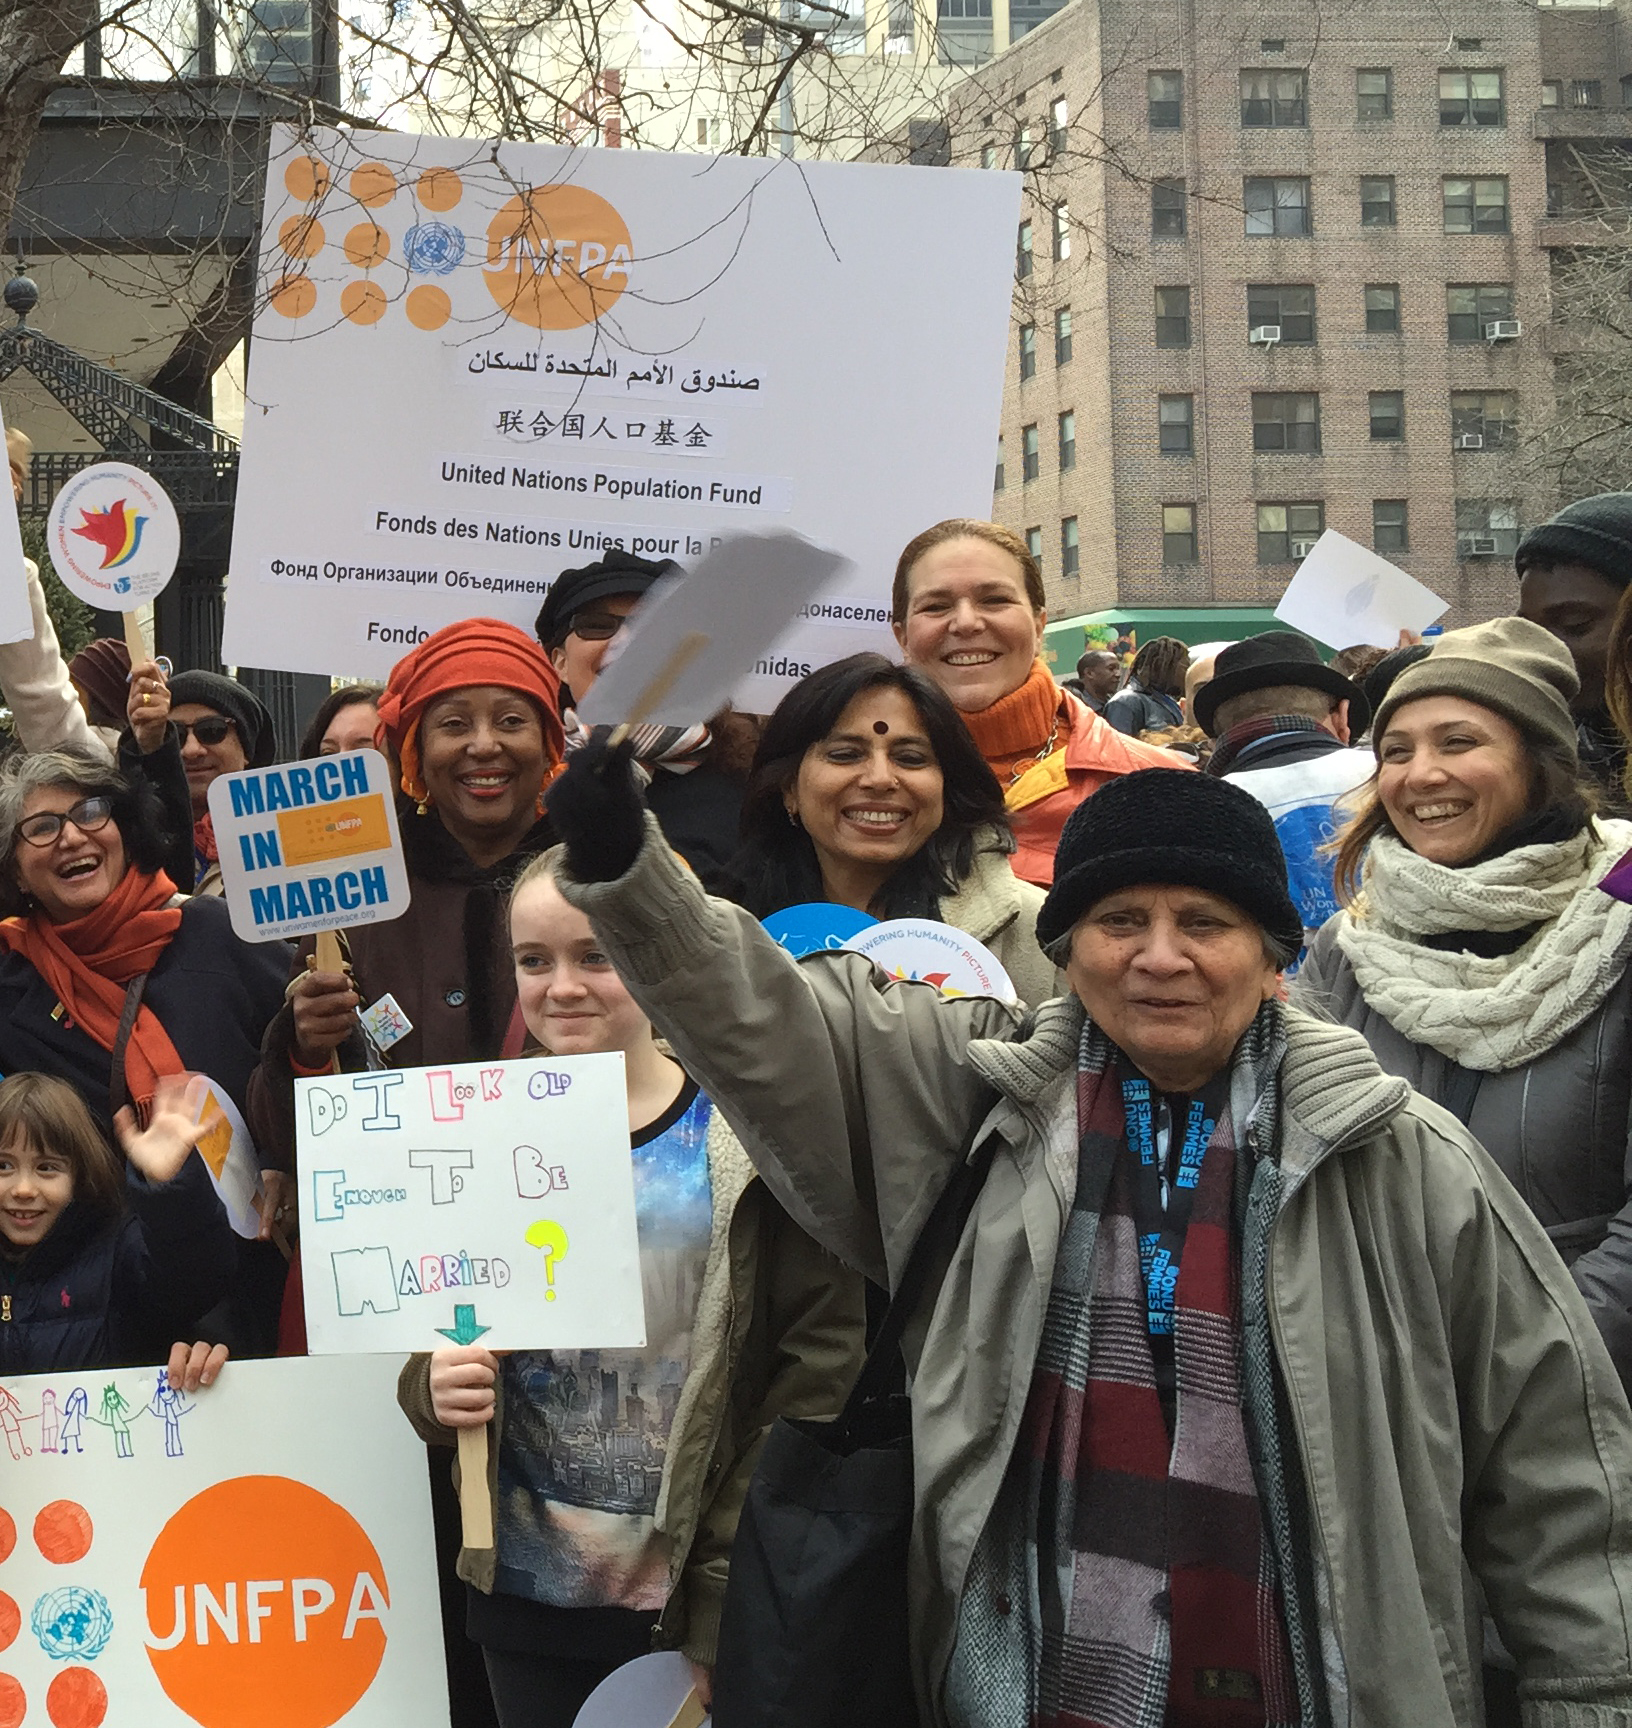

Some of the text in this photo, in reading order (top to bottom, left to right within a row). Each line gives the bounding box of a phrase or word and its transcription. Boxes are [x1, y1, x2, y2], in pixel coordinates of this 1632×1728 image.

[483, 234, 635, 279] UNFPA
[468, 351, 760, 394] صندوق الأمم المتحدة للسكان
[496, 408, 713, 448] 联合国人口基金
[441, 462, 762, 505] United Nations Population Fund
[376, 511, 437, 536] Fonds
[443, 518, 479, 539] des
[485, 522, 561, 548] Nations
[568, 529, 624, 552] Unies
[631, 536, 680, 560] pour
[685, 536, 702, 556] la
[270, 559, 318, 580] Фонд
[323, 561, 438, 585] Организации
[444, 569, 552, 594] Объединен
[368, 622, 812, 678] Fondo nidas
[228, 756, 369, 818] MARCH
[239, 829, 282, 872] IN
[249, 866, 389, 926] MARCH
[907, 929, 963, 952] HUMANITY
[961, 950, 993, 991] PICTURE
[353, 1073, 403, 1131] I
[528, 1071, 571, 1100] OLD
[1124, 1101, 1154, 1166] ONU FEMMES
[1181, 1100, 1204, 1165] FEMMES
[513, 1145, 569, 1199] BE
[1148, 1248, 1177, 1311] ONU FEMMES
[141, 1571, 391, 1651] UNFPA
